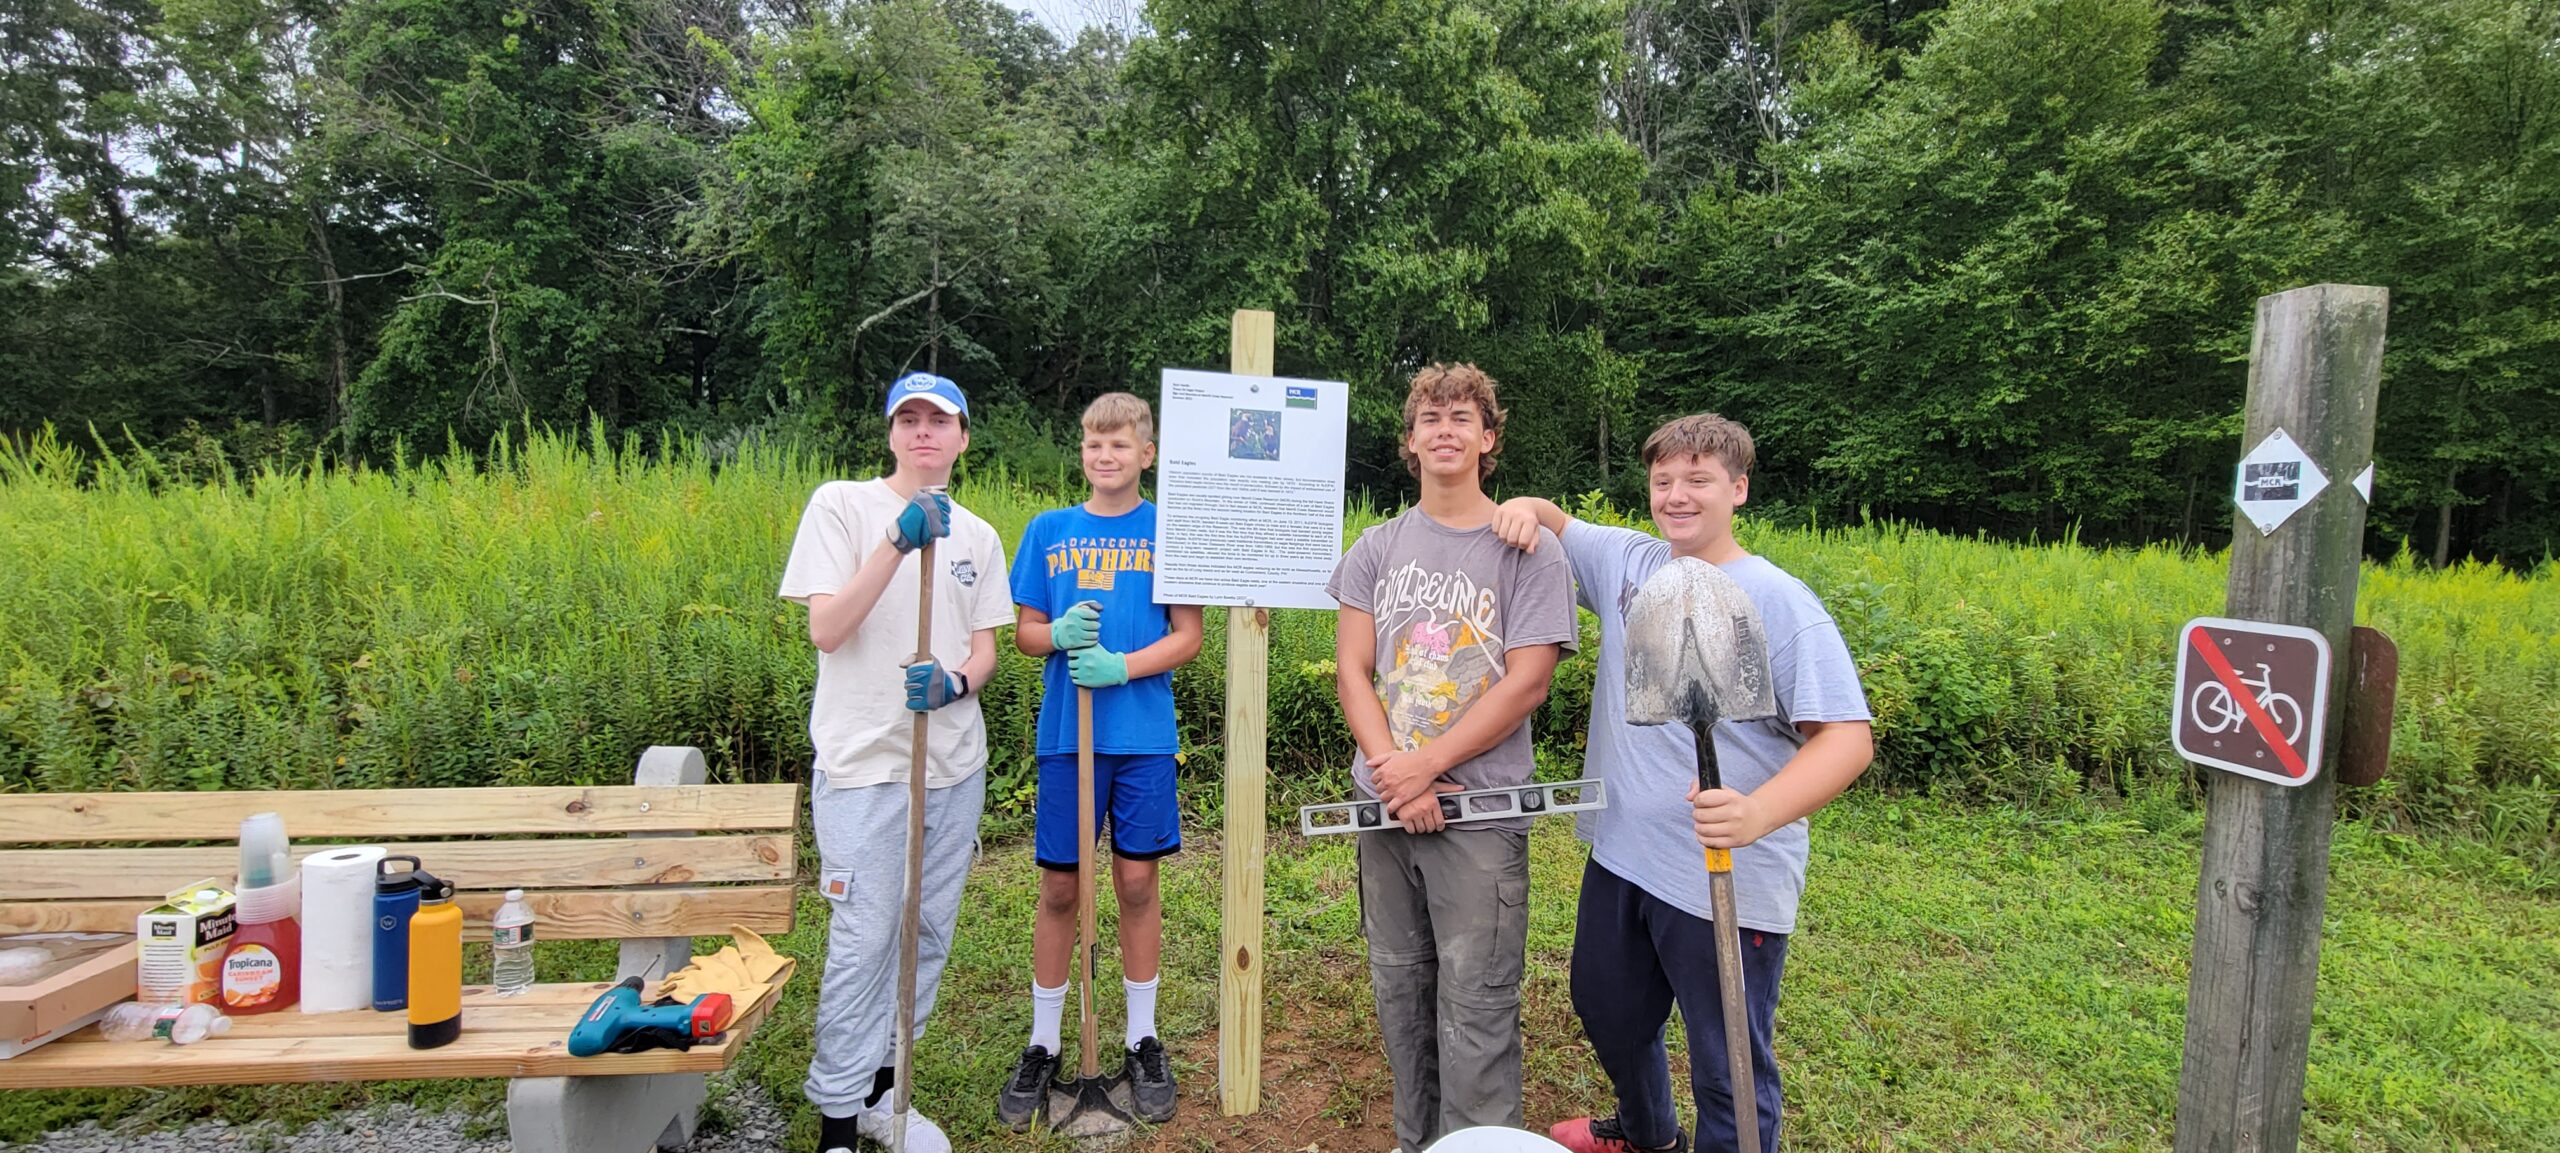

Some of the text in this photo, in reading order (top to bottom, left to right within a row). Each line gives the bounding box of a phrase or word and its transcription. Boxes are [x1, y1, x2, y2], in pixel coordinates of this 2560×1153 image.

[2260, 478, 2282, 487] MCR
[1061, 537, 1149, 549] LOPATCONG
[205, 923, 233, 941] Maid
[228, 958, 273, 970] Tropicana
